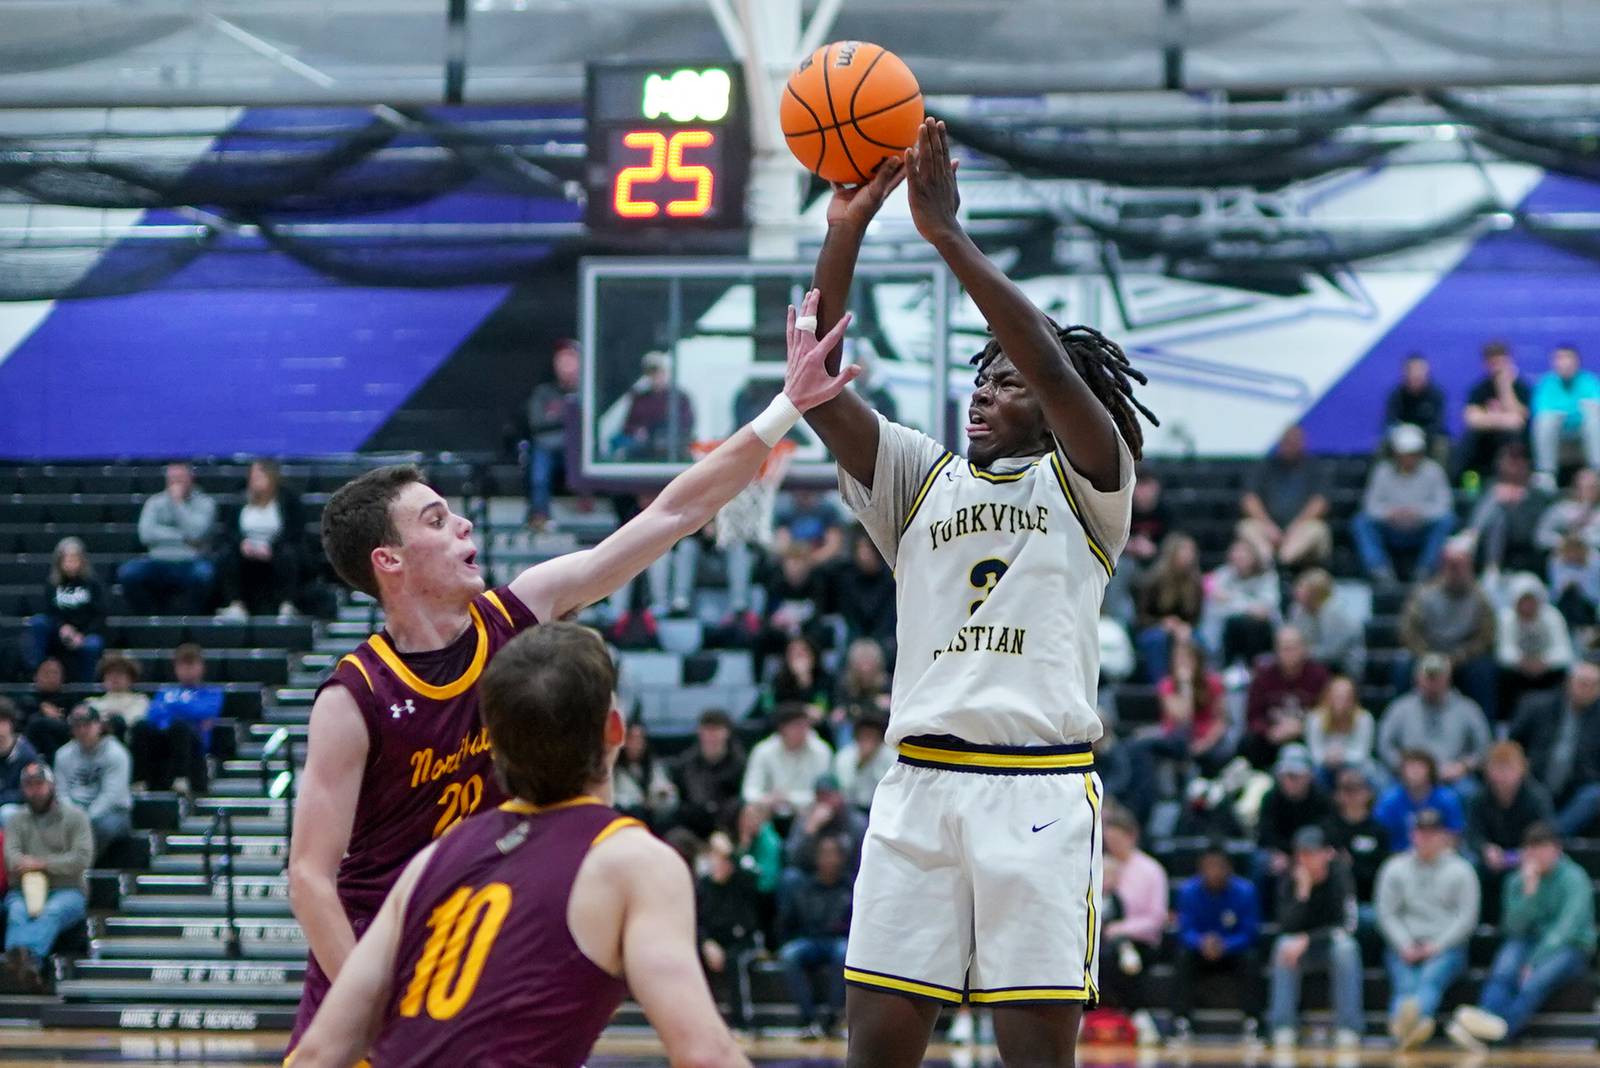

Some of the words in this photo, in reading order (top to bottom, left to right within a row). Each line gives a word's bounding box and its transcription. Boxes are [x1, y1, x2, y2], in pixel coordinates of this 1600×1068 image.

[614, 131, 714, 217] 25
[432, 774, 484, 839] 20
[400, 882, 512, 1020] 10
